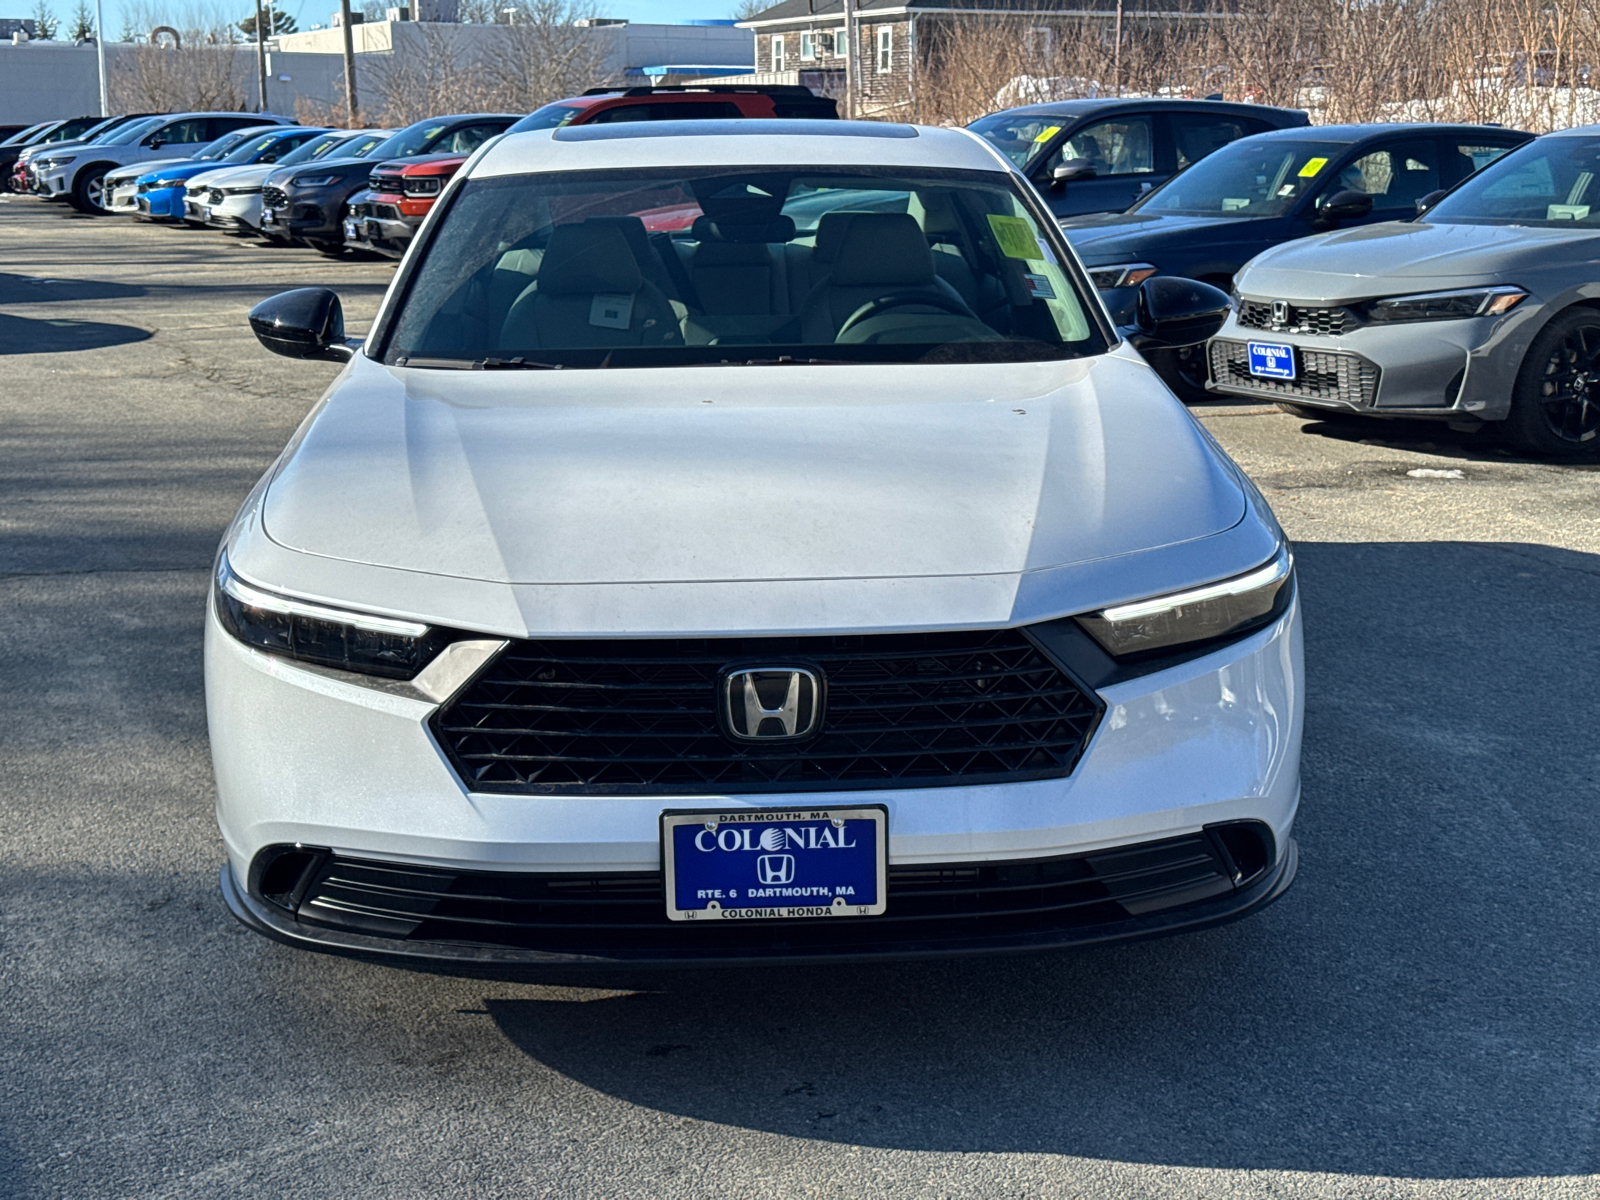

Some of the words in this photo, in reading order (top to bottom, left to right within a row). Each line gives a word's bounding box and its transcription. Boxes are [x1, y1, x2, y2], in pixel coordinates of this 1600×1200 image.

[810, 812, 830, 820] MA
[694, 826, 857, 852] COLONIAL
[697, 889, 726, 899] RTE.
[729, 889, 738, 898] 6
[748, 886, 832, 898] DARTMOUTH,
[835, 886, 855, 895] MA
[721, 908, 784, 919] COLONIAL
[787, 907, 833, 917] HONDA
